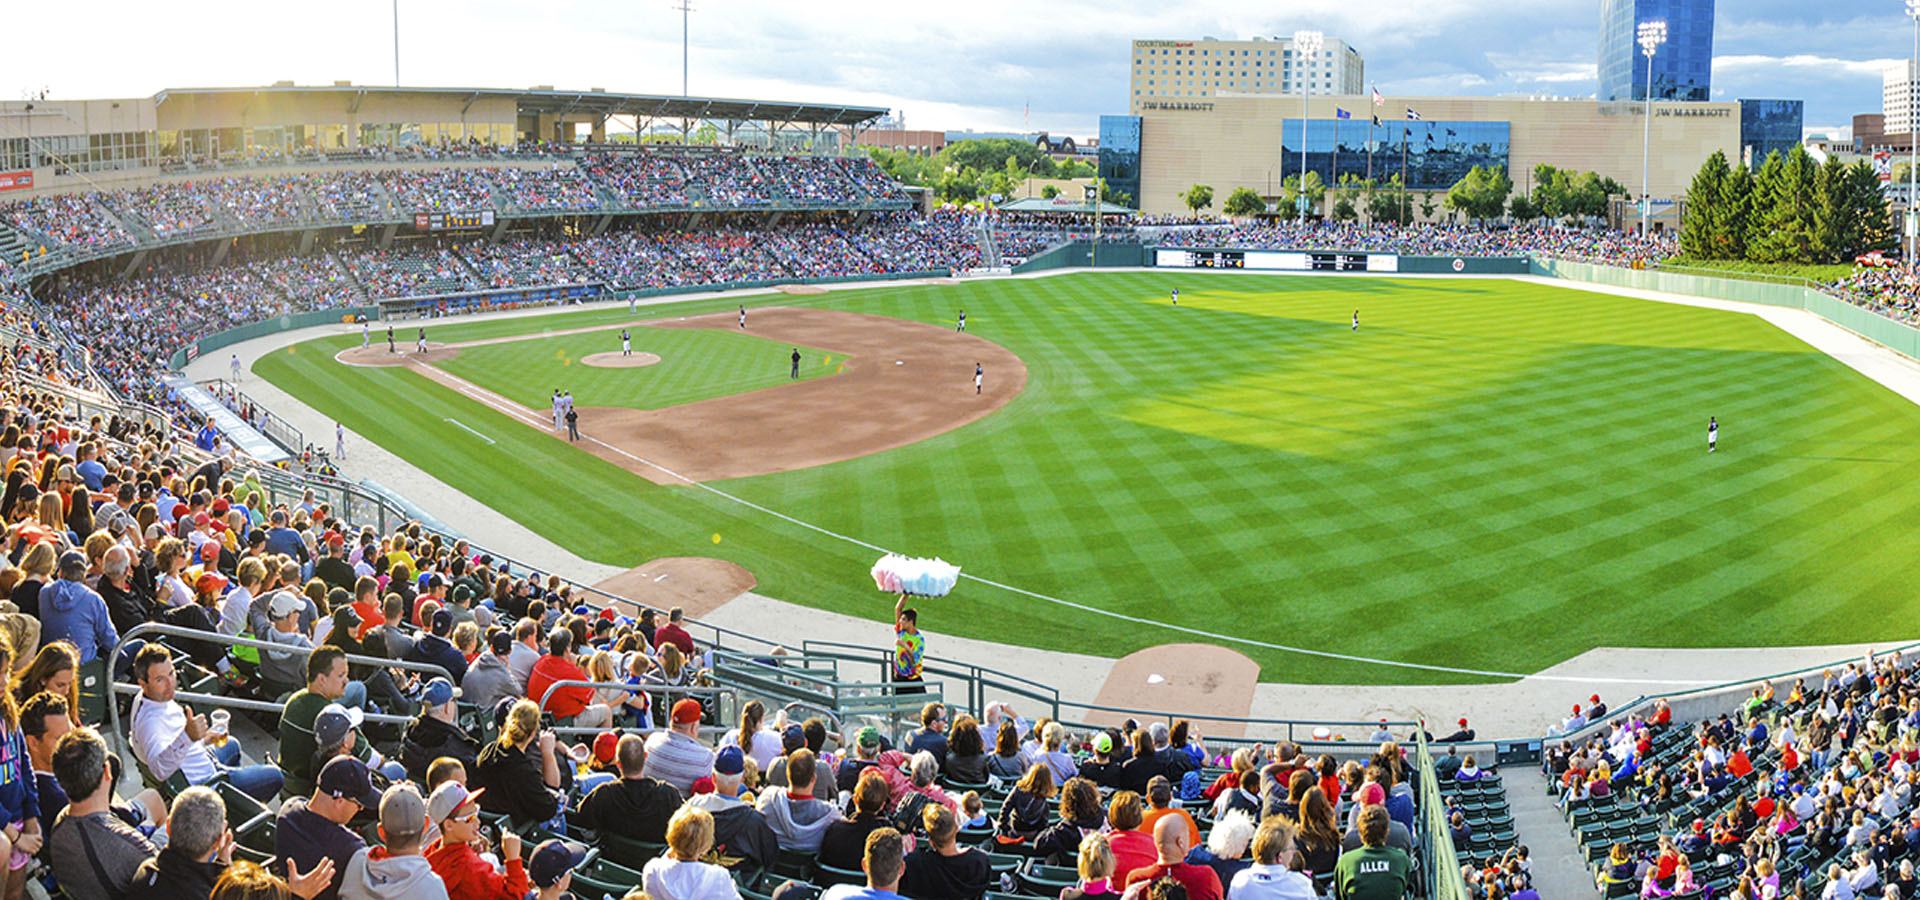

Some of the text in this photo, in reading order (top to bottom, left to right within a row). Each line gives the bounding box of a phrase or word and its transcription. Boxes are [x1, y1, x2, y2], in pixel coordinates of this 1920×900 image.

[1143, 102, 1215, 111] JW MARRIOTT
[1655, 108, 1731, 117] JW MARRIOTT
[1360, 860, 1390, 873] ALLEN
